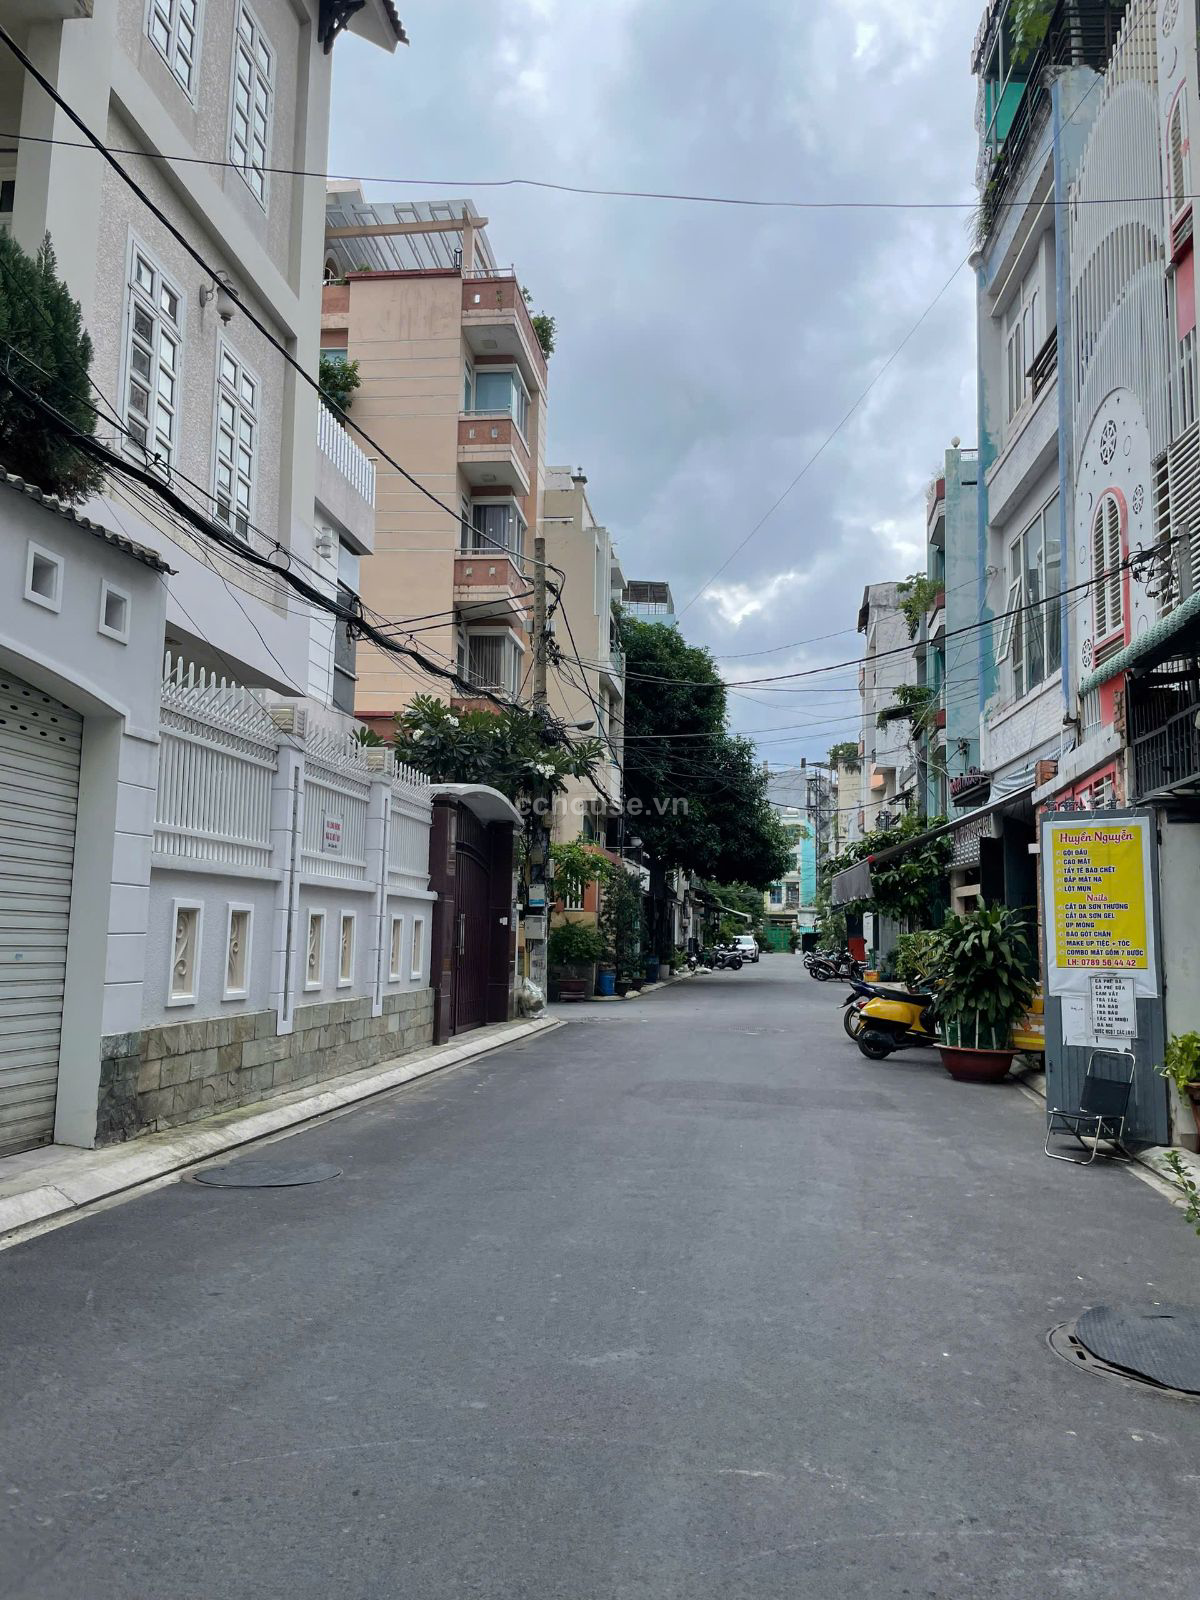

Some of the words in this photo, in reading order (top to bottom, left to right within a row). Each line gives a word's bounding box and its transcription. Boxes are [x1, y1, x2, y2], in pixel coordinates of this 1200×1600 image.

[1060, 832, 1091, 845] Huyền
[1094, 830, 1133, 844] Nguyễn
[1086, 894, 1108, 902] Nails
